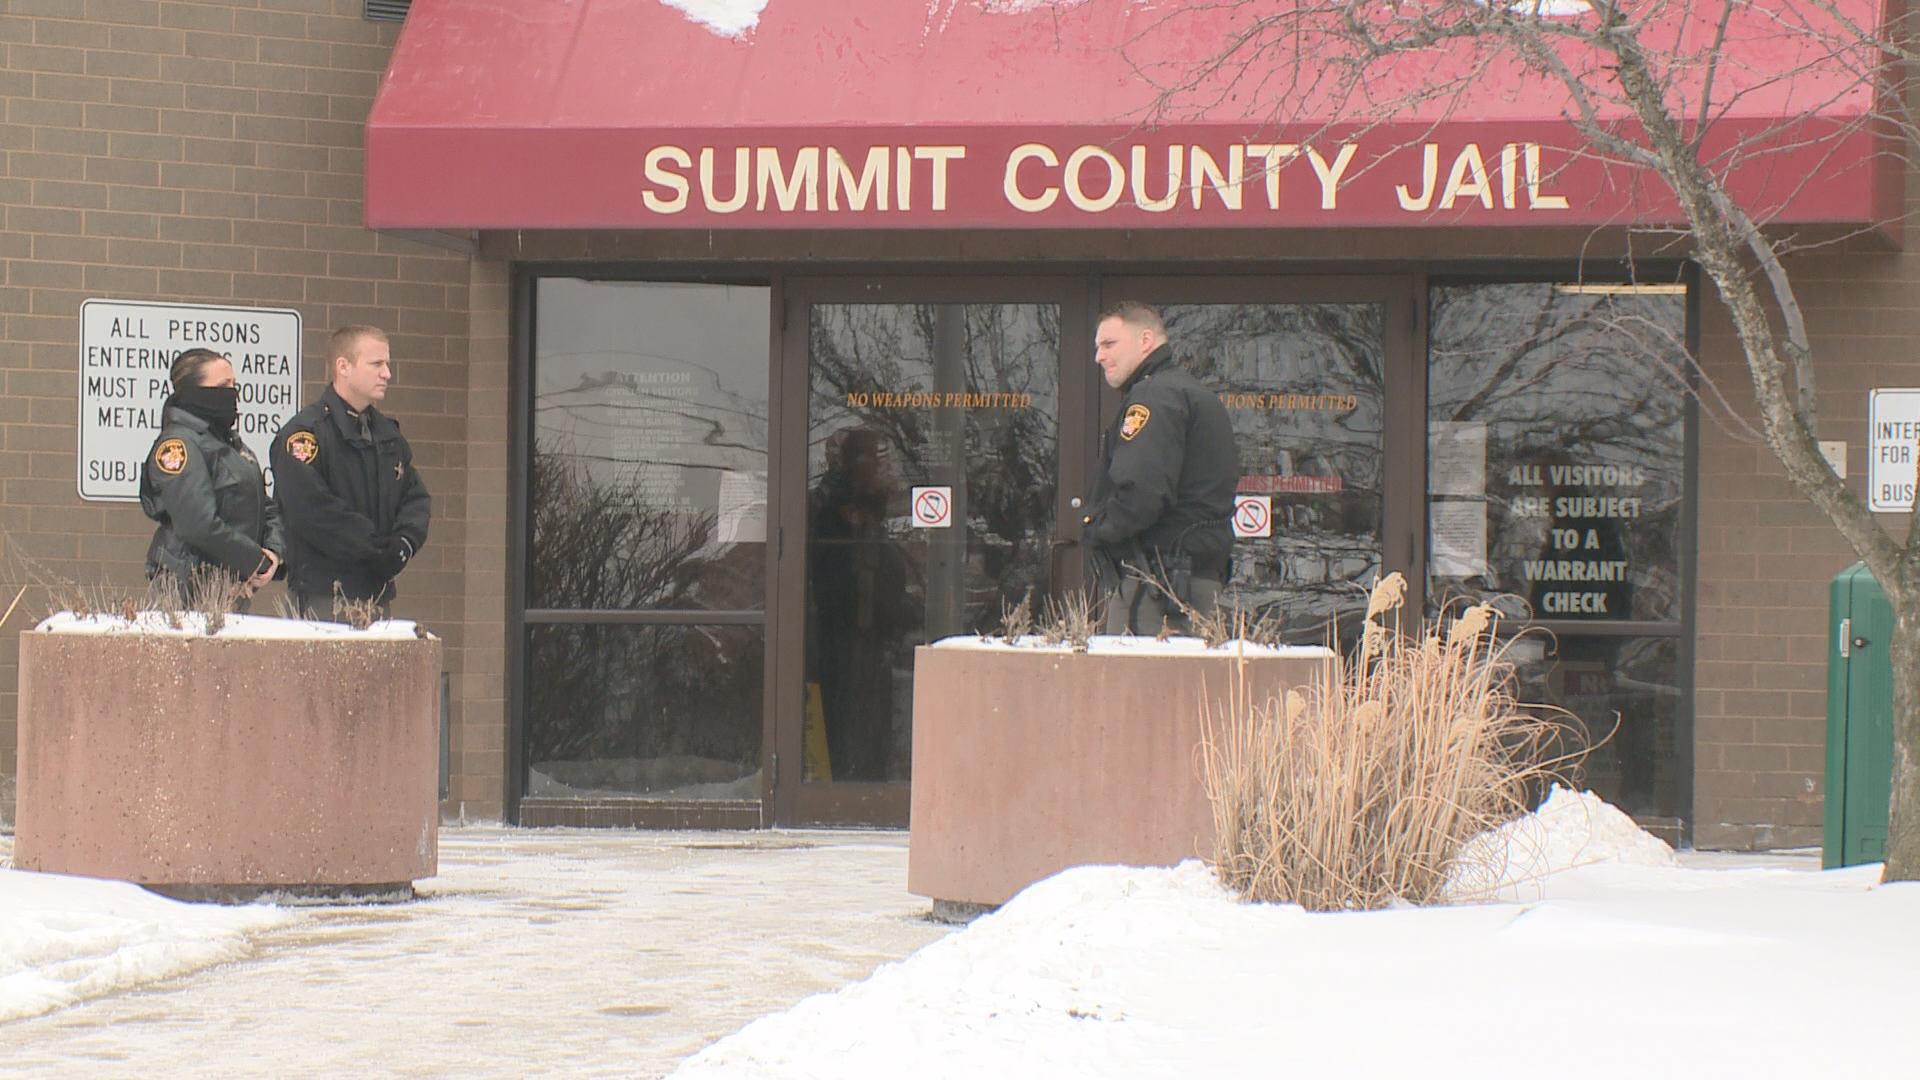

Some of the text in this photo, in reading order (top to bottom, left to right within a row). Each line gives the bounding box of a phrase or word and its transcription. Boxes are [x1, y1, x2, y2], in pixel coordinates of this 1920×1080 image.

[641, 142, 1569, 214] SUMMIT COUNTY JAIL
[110, 317, 261, 344] ALL PERSONS
[241, 353, 291, 376] AREA
[88, 376, 292, 405] MUST PA ROUGH
[847, 392, 1031, 408] NO WEAPONS PERMITTED
[1268, 393, 1358, 410] PERMITTED
[98, 406, 162, 429] METAL
[1880, 445, 1910, 464] FOR
[89, 460, 137, 482] SUBJ
[1508, 465, 1645, 487] ALL VISITORS
[1511, 497, 1642, 518] ARE SUBJECT
[1552, 529, 1600, 550] TO A
[1524, 561, 1627, 582] WARRANT
[1543, 592, 1608, 613] CHECK
